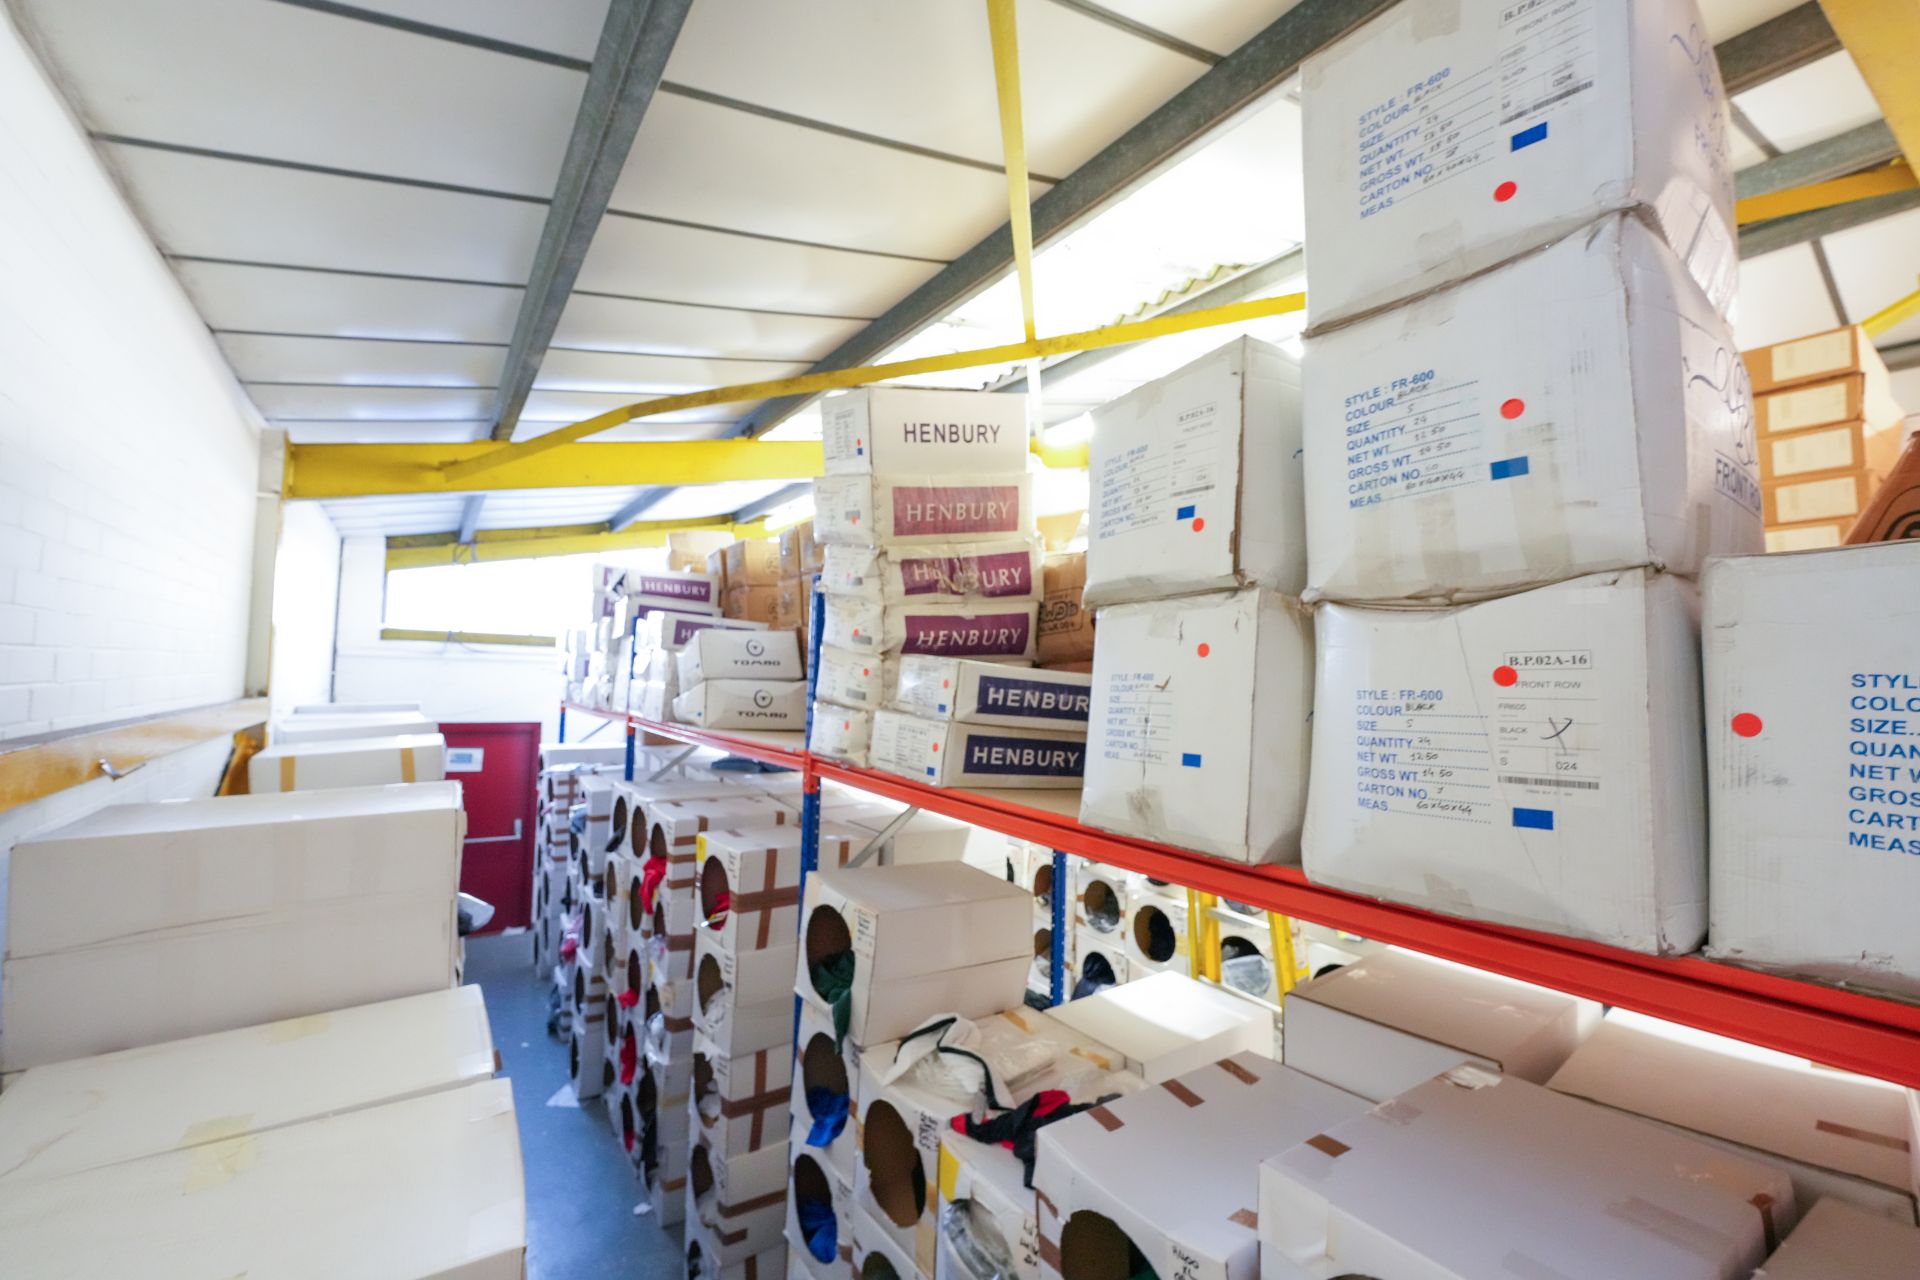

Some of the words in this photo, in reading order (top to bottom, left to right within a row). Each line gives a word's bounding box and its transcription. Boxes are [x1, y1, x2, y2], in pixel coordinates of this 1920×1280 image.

[1360, 98, 1395, 125] STYLE
[1407, 67, 1450, 97] FR-600
[1360, 104, 1410, 138] COLOUR
[1360, 132, 1384, 151] SIZE
[1360, 126, 1420, 165] QUANTITY
[1360, 160, 1381, 178] NET
[1386, 149, 1404, 165] WT
[1360, 165, 1402, 192] GROSS
[1405, 152, 1425, 168] WT
[1360, 174, 1410, 206] CARTON
[1414, 164, 1433, 180] NO
[1360, 197, 1393, 220] MEAS
[1345, 387, 1380, 408] STYLE
[1391, 370, 1435, 391] FR-600
[1345, 398, 1394, 421] COLOUR
[904, 423, 1000, 443] HENBURY
[1346, 420, 1371, 436] SIZE
[1347, 425, 1405, 451] QUANTITY
[1348, 451, 1369, 465] NET
[1373, 444, 1390, 458] WT
[1348, 460, 1389, 479] GROSS
[1392, 454, 1411, 467] WT
[1349, 475, 1397, 494] CARTON
[1401, 469, 1420, 481] NO
[1350, 494, 1382, 509] MEAS
[907, 501, 1010, 522] HENBURY
[644, 581, 708, 596] HENBURY
[916, 628, 1023, 647] HENBURY
[1509, 655, 1588, 666] B.P.02A-16
[1515, 680, 1551, 689] FRONT
[1554, 681, 1582, 689] ROW
[1851, 674, 1920, 689] STYL
[988, 687, 1089, 712] HENBUR
[1356, 690, 1388, 700] STYLE
[1399, 690, 1443, 701] FR-600
[738, 711, 788, 719] TOMBO
[1356, 705, 1402, 716] COLOUR
[1356, 720, 1377, 731] SIZE
[1850, 718, 1907, 735] SIZE
[1356, 736, 1413, 748] QUANTITY
[973, 746, 1079, 768] HENBURY
[1356, 751, 1376, 762] NET
[1379, 753, 1398, 764] WT
[1555, 761, 1578, 770] 024
[1357, 766, 1396, 780] GROSS
[1399, 770, 1418, 781] WT
[1850, 764, 1901, 781] NET
[1357, 782, 1404, 797] CARTON
[1408, 787, 1428, 800] NO
[1358, 797, 1389, 811] MEAS
